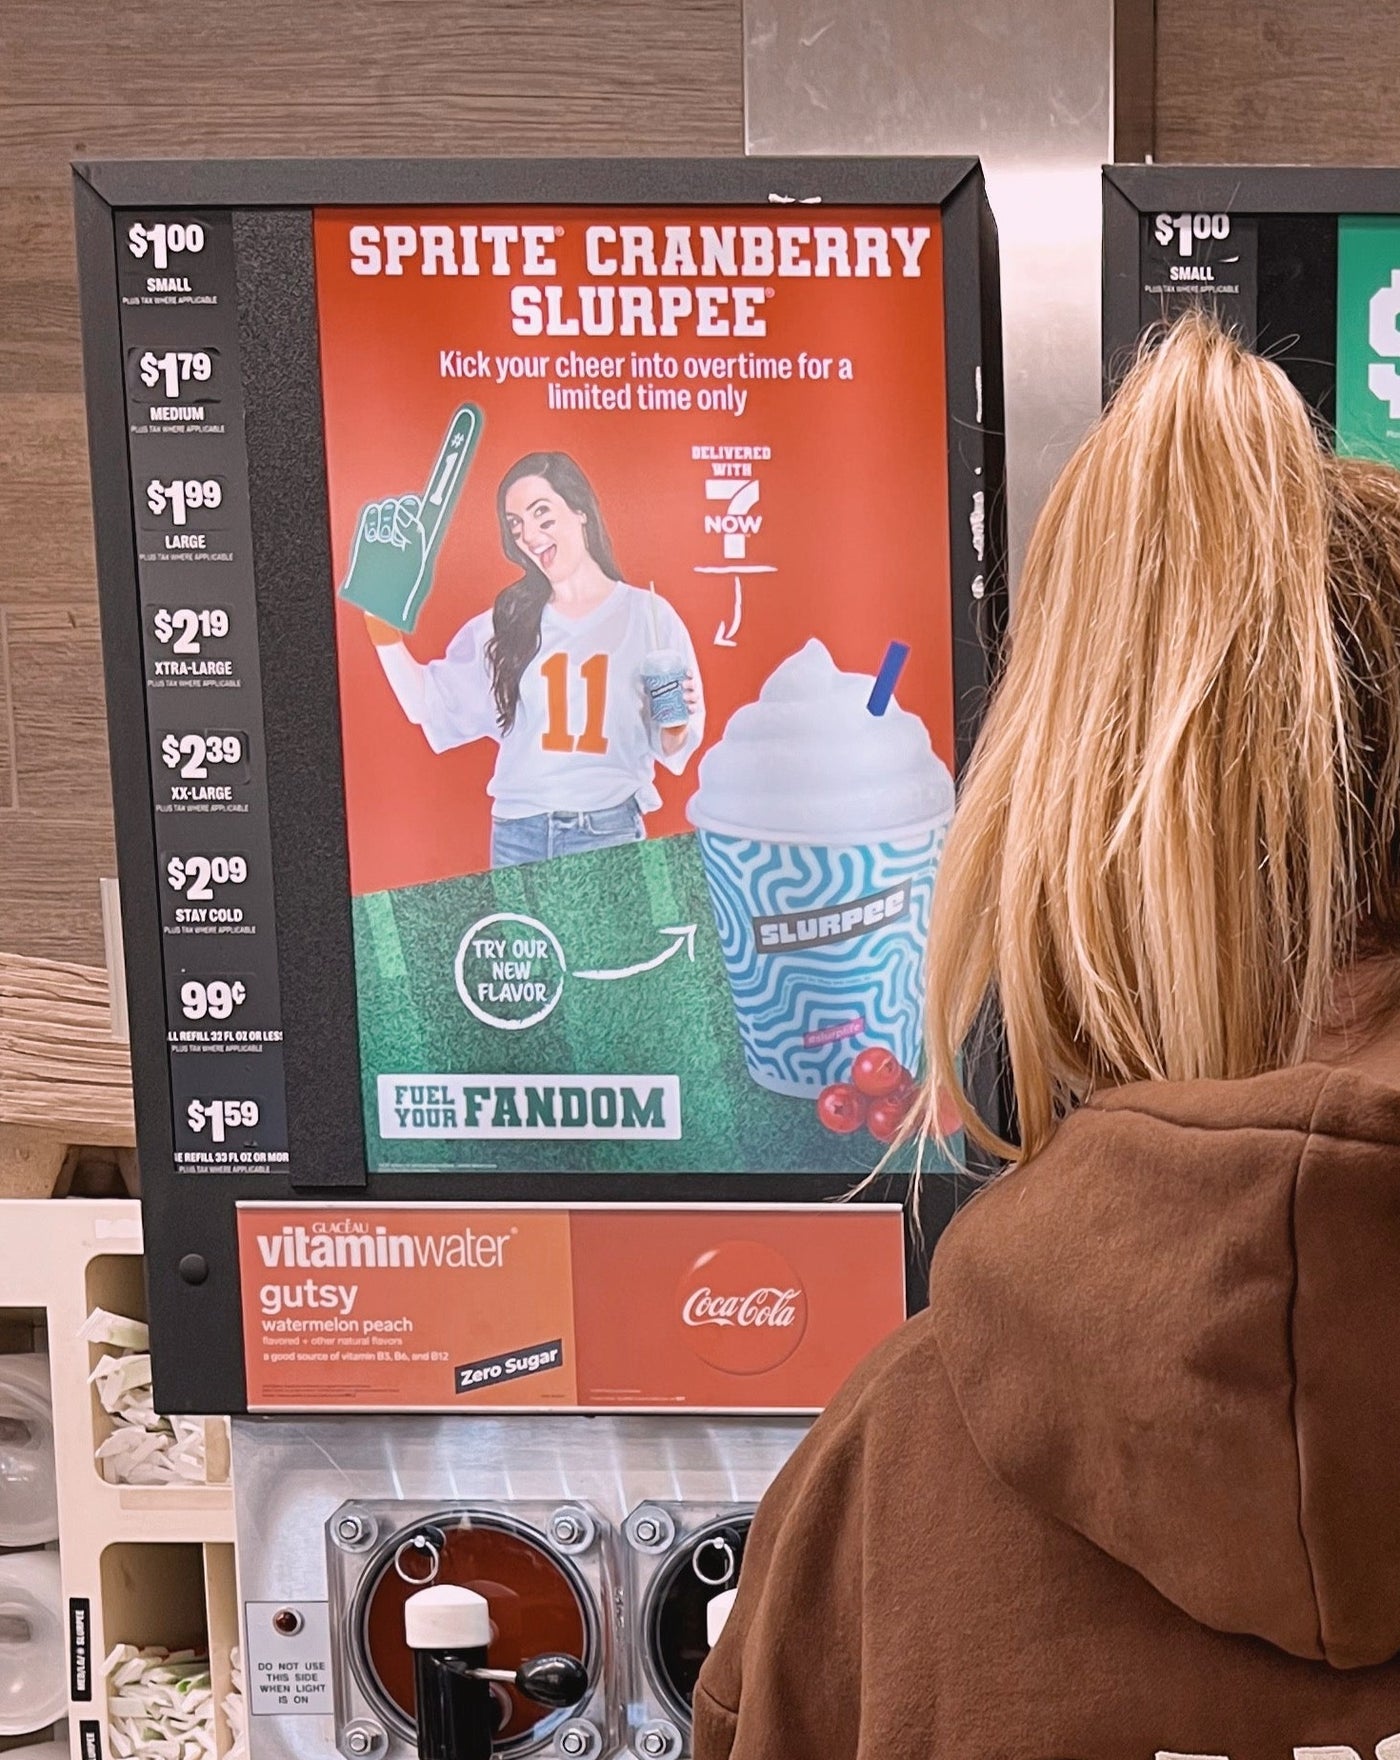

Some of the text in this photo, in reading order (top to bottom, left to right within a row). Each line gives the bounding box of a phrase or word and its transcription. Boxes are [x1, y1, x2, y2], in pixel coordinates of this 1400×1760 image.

[585, 226, 931, 277] CRANBERRY
[1170, 266, 1214, 280] SMALL
[147, 278, 192, 292] SMALL
[439, 350, 853, 384] Kick your cheer into overtime for a
[547, 383, 747, 416] limited time only
[150, 407, 204, 421] MEDIUM
[691, 446, 771, 460] DELIVERED
[711, 463, 752, 476] WITH
[704, 515, 763, 534] NOW
[165, 535, 206, 549] LARGE
[155, 661, 233, 675] XTRA-LARGE
[540, 652, 609, 755] 11
[171, 786, 233, 800] XX-LARGE
[175, 909, 243, 922] STAY COLD
[760, 890, 905, 945] SLURPEE
[472, 937, 548, 958] TRY OUR
[492, 961, 531, 980] NEW
[181, 981, 246, 1019] 99¢
[478, 982, 548, 1002] FLAVOR
[180, 1031, 262, 1041] REFILL 32 FL OZ OR
[395, 1085, 456, 1105] FUEL
[463, 1086, 666, 1128] FANDOM
[395, 1107, 458, 1128] YOUR
[311, 1218, 369, 1234] GLACÉAU
[259, 1278, 359, 1315] gutsy
[682, 1287, 802, 1327] Coca-Cola
[261, 1316, 413, 1335] watermelon peach
[263, 1353, 269, 1361] a
[271, 1351, 295, 1363] good
[297, 1353, 329, 1361] source
[330, 1351, 340, 1361] of
[341, 1351, 375, 1361] vitamin
[412, 1352, 430, 1361] and
[431, 1352, 449, 1362] B12
[460, 1349, 559, 1387] Zero Sugar
[258, 1662, 325, 1671] DO NOT USE
[266, 1673, 318, 1682] THIS SIDE
[259, 1684, 325, 1693] WHEN LIGHT
[278, 1695, 308, 1704] IS ON
